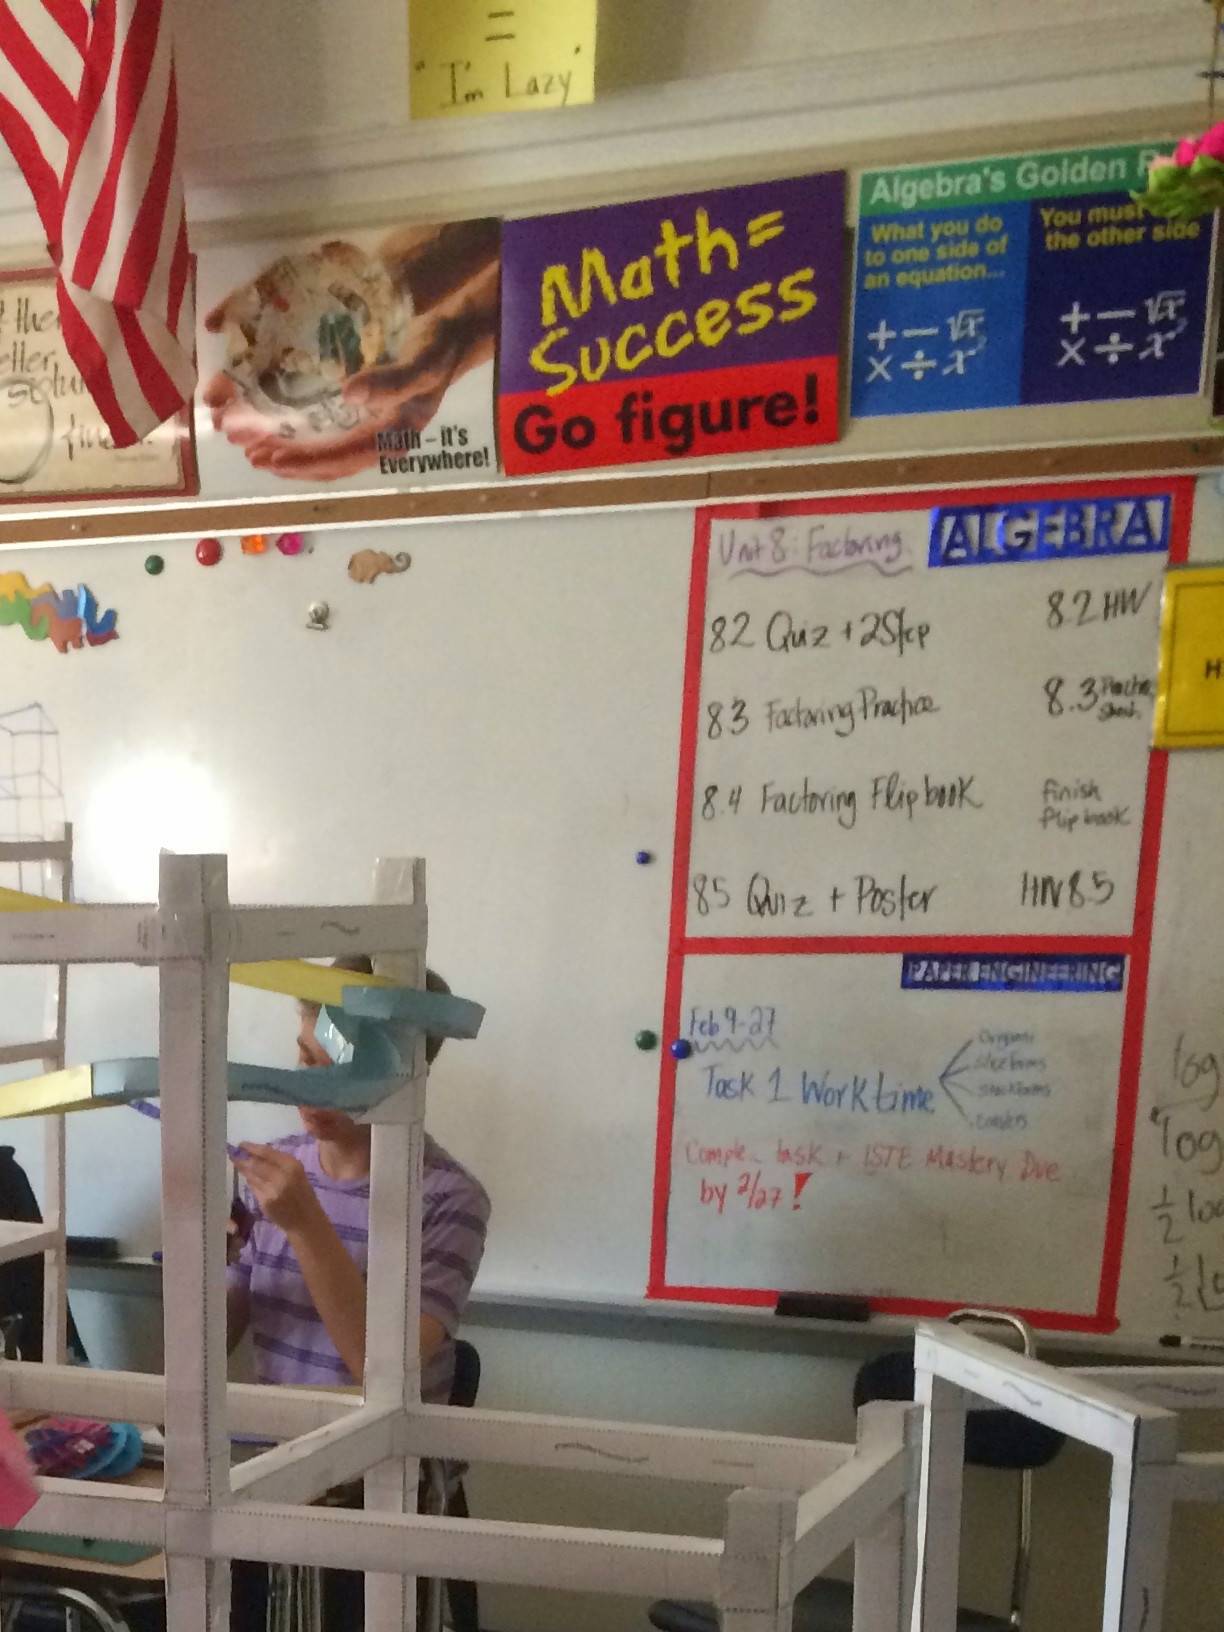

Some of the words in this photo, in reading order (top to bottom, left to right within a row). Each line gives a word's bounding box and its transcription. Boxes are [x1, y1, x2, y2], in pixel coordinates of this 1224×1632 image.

[869, 166, 1006, 209] Algebra's
[1015, 157, 1126, 191] Golden
[871, 221, 924, 243] What
[930, 219, 969, 243] you
[975, 213, 1003, 234] do
[1040, 206, 1082, 228] You
[864, 250, 886, 267] to
[891, 246, 930, 264] one
[936, 239, 980, 260] side
[986, 232, 1009, 256] of
[1045, 231, 1081, 250] the
[1086, 226, 1146, 248] other
[864, 272, 890, 290] an
[529, 267, 819, 397] Success
[512, 404, 596, 455] Go
[617, 372, 820, 456] figure!
[377, 429, 421, 452] Math
[379, 446, 490, 474] Everywhere!
[940, 500, 1166, 560] ALGEBRA
[760, 776, 858, 830] Factoring
[854, 873, 938, 921] Poster
[702, 1064, 755, 1100] Task
[699, 1177, 727, 1214] by
